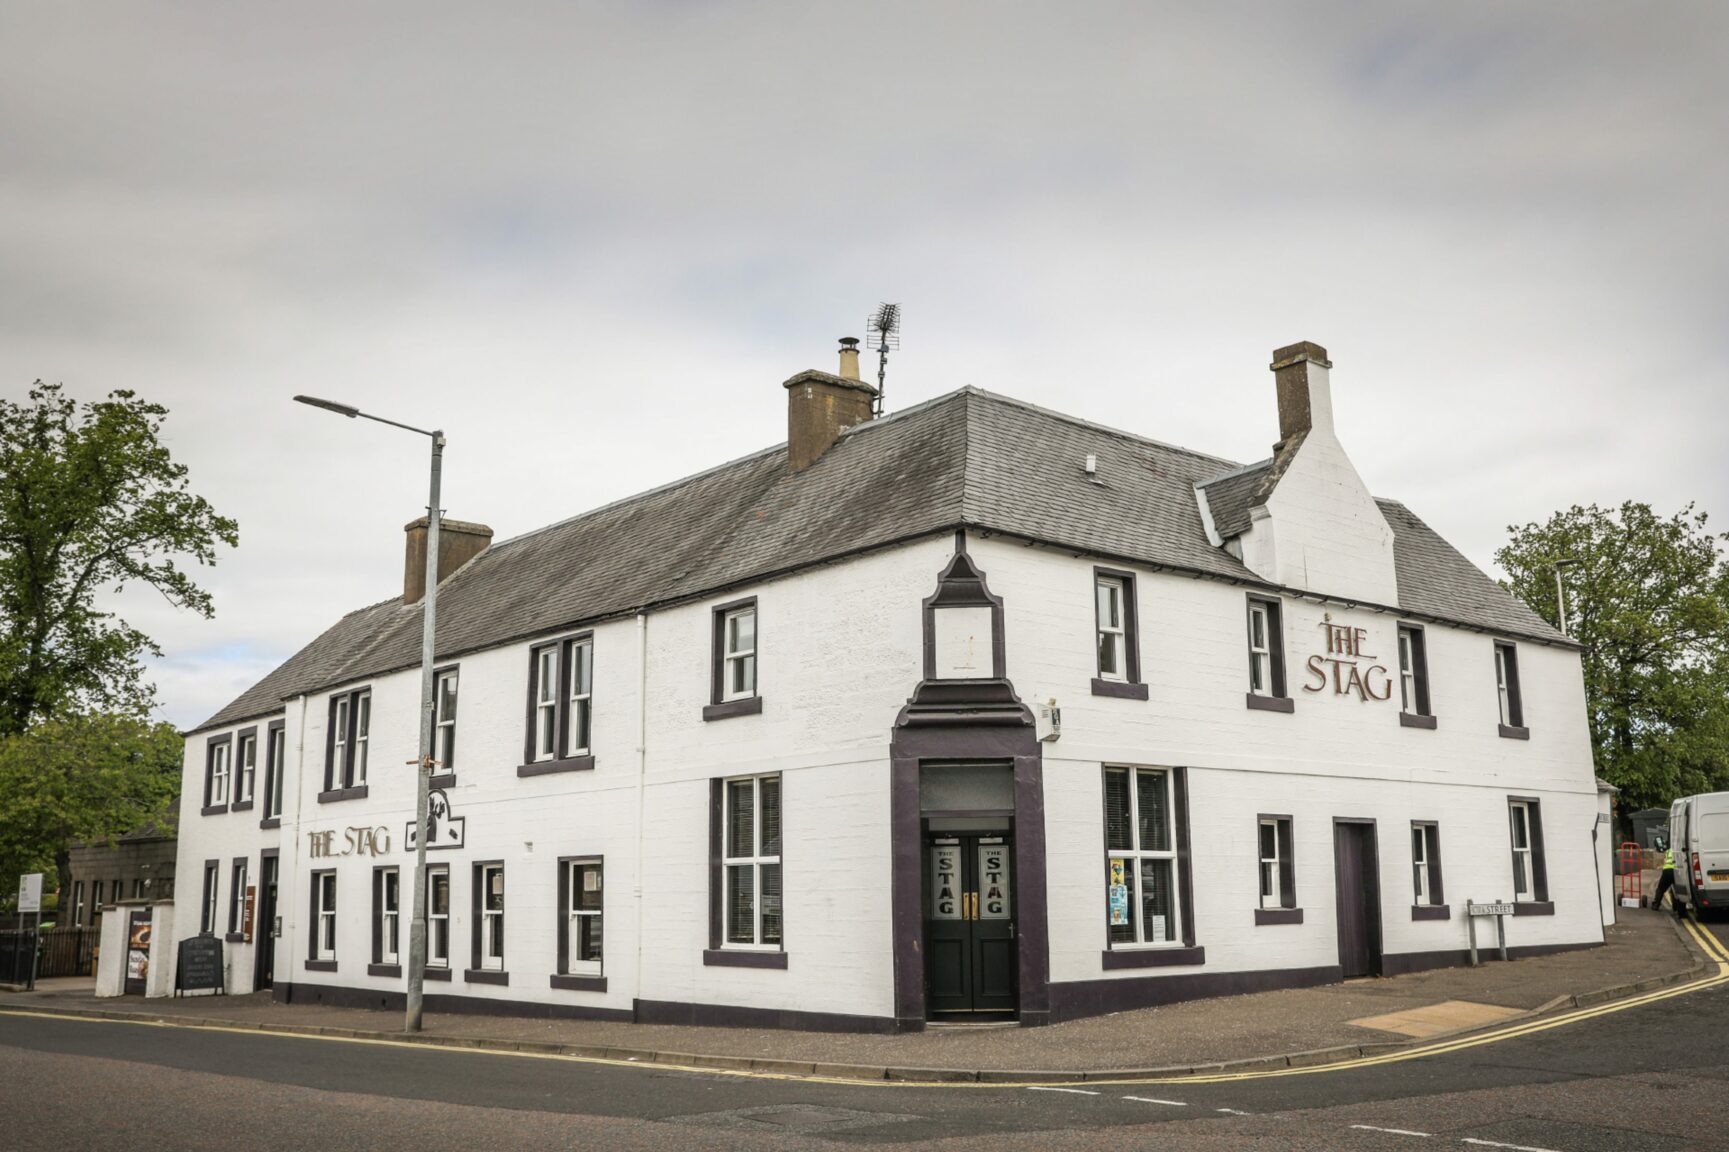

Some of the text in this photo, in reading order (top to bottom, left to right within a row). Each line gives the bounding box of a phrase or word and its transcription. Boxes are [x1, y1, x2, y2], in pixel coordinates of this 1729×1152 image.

[1319, 622, 1377, 659] THE
[1304, 655, 1392, 702] STAG
[307, 825, 390, 858] THE STAG
[938, 858, 954, 914] STAG
[986, 857, 1003, 914] STAG
[1486, 905, 1512, 914] STREET
